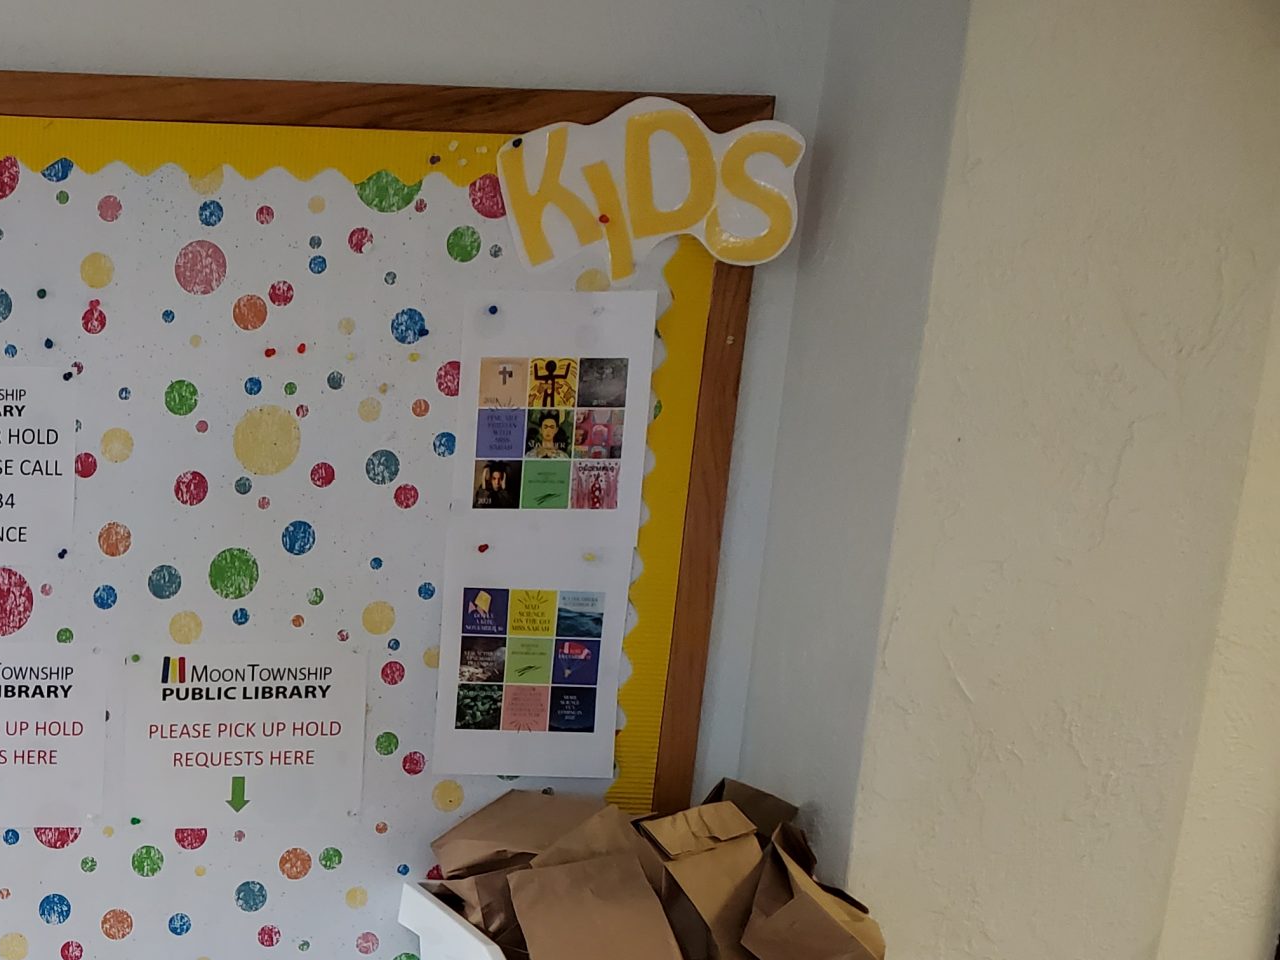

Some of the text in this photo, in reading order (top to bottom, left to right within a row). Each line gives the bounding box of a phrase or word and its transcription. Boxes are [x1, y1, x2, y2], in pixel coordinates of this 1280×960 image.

[500, 108, 803, 282] KIDS
[8, 428, 59, 445] HOLD
[20, 459, 62, 476] CALL
[190, 664, 332, 683] MOON TOWNSHIP
[161, 684, 332, 701] PUBLIC LIBRARY
[6, 721, 29, 736] UP
[35, 721, 83, 736] HOLD
[149, 721, 342, 739] PLEASE PICK UP HOLD
[13, 750, 58, 765] HERE
[173, 750, 315, 769] REQUESTS HERE
